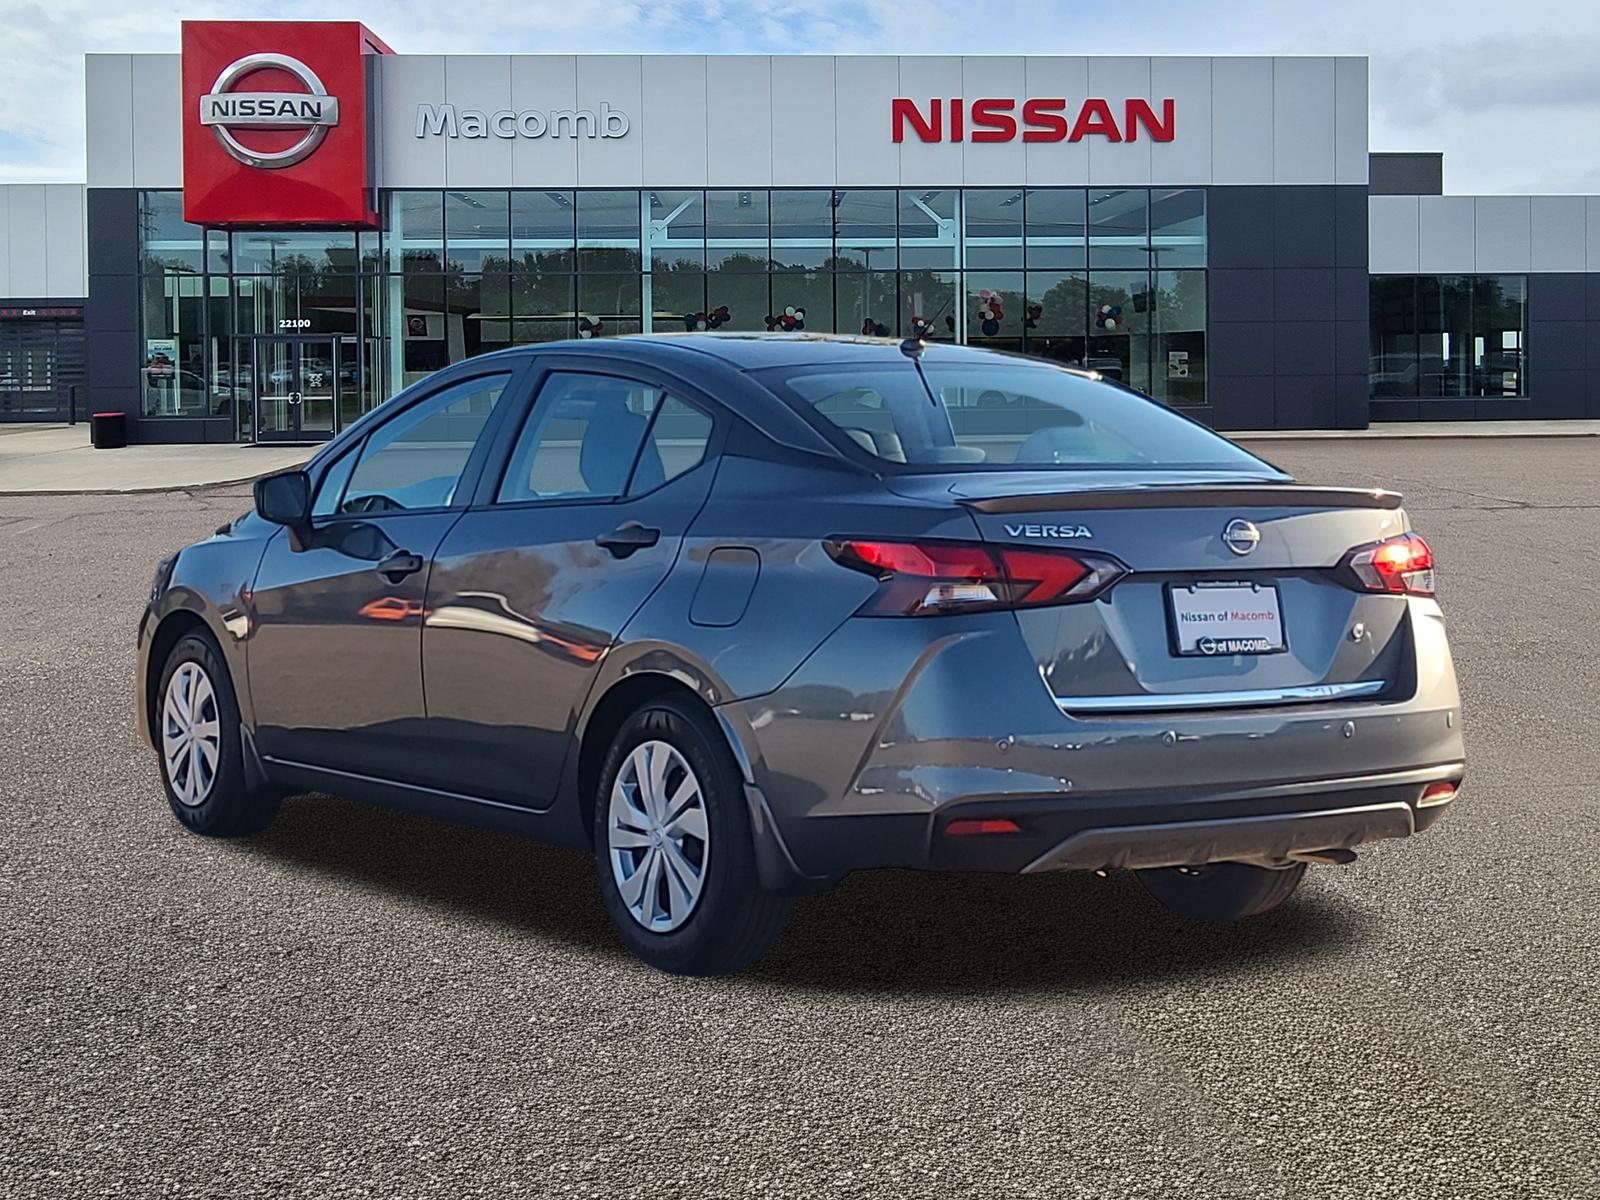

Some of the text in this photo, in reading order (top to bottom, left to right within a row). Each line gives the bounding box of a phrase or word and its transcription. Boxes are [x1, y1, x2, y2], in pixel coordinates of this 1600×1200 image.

[211, 99, 323, 118] NISSAN
[414, 101, 631, 139] Macomb
[892, 98, 1175, 143] NISSAN
[279, 319, 311, 328] 22100
[1004, 524, 1093, 539] VERSA
[1181, 610, 1275, 622] Nissan of Macomb
[1228, 640, 1270, 652] MACOMB
